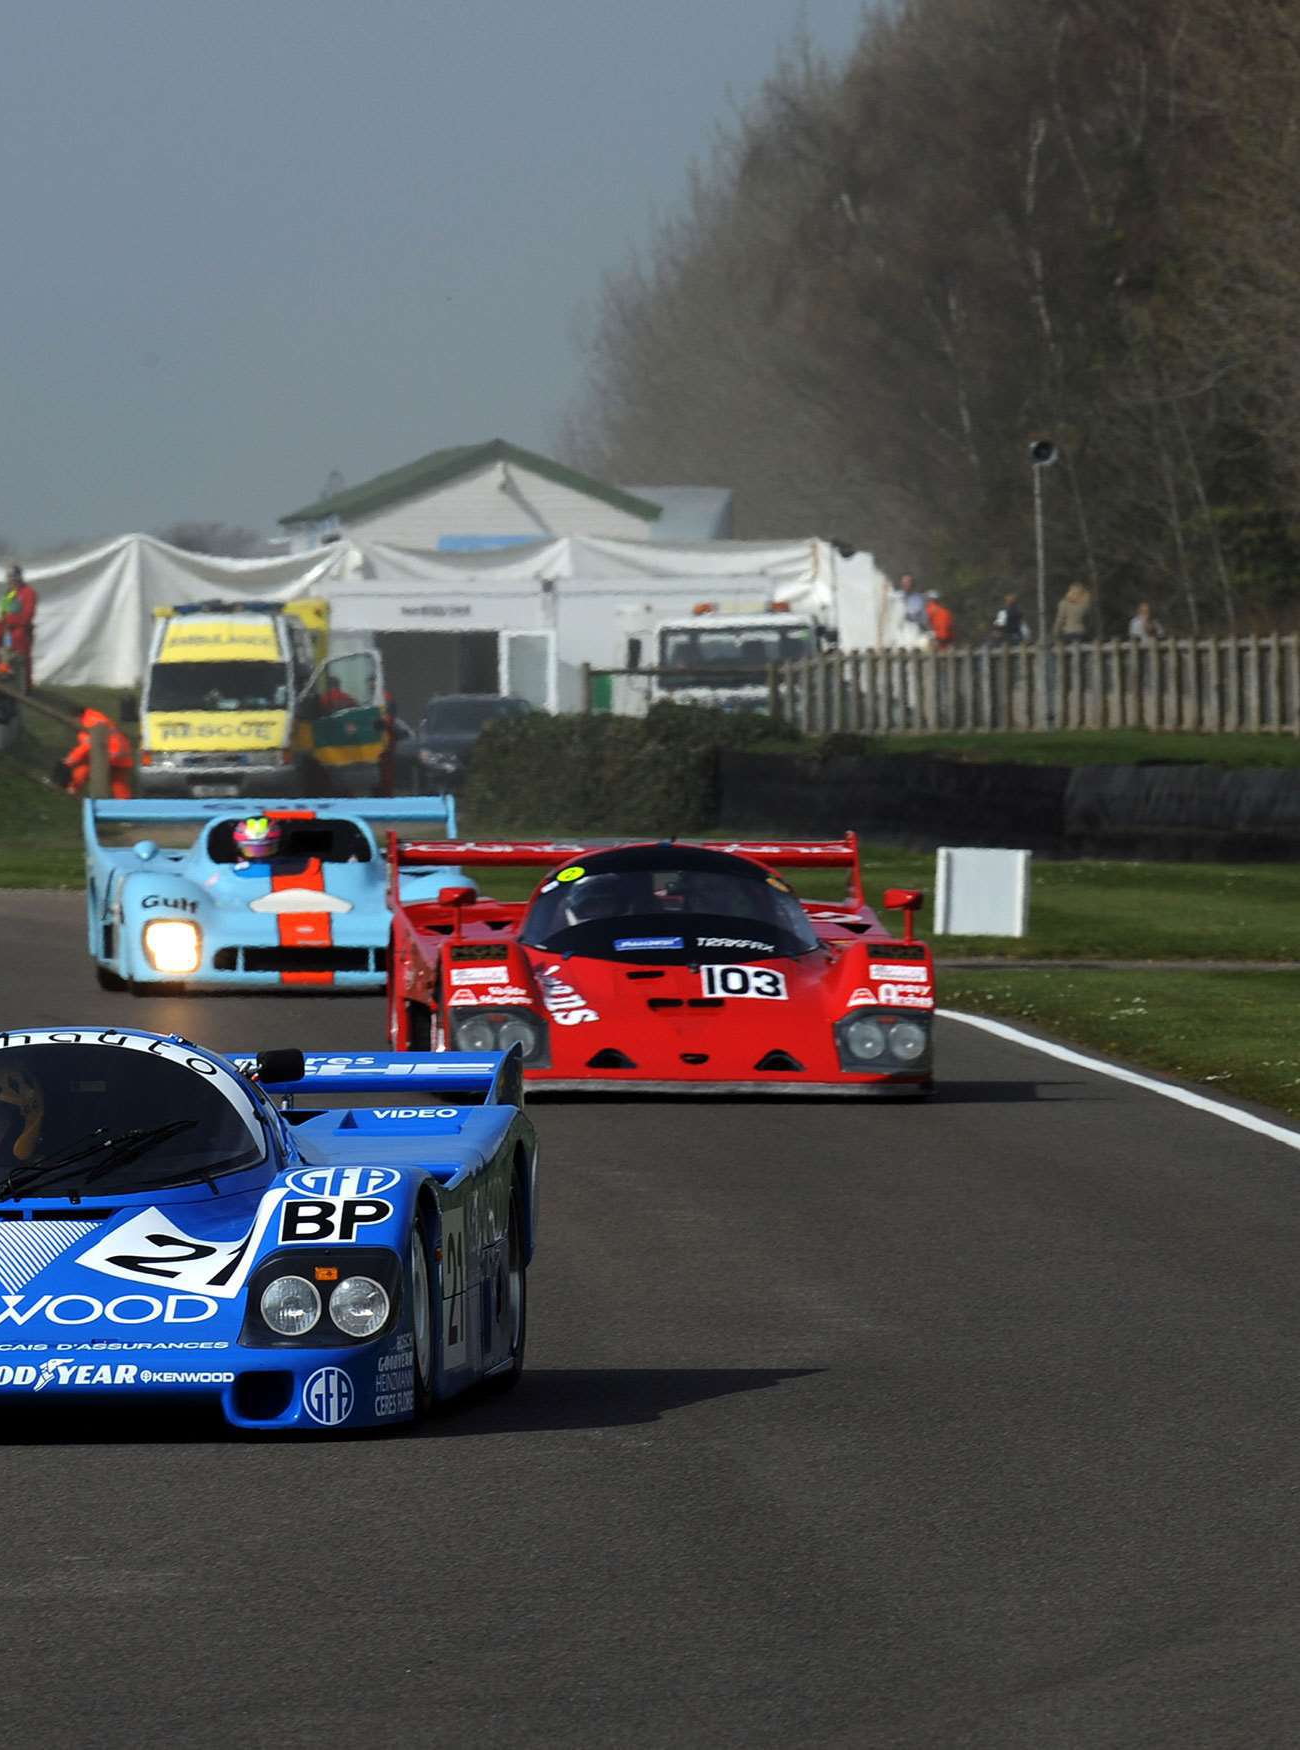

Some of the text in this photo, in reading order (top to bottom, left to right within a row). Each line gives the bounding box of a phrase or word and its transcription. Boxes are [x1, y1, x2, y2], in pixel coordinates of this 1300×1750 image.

[141, 894, 198, 914] Gulf
[704, 966, 782, 997] 103
[371, 1108, 459, 1119] VIDEO
[280, 1199, 391, 1242] BP
[105, 1216, 259, 1286] 21
[57, 1341, 229, 1351] D'ASSURANCES
[150, 1372, 235, 1383] KENWOOD
[303, 1367, 354, 1426] GFA
